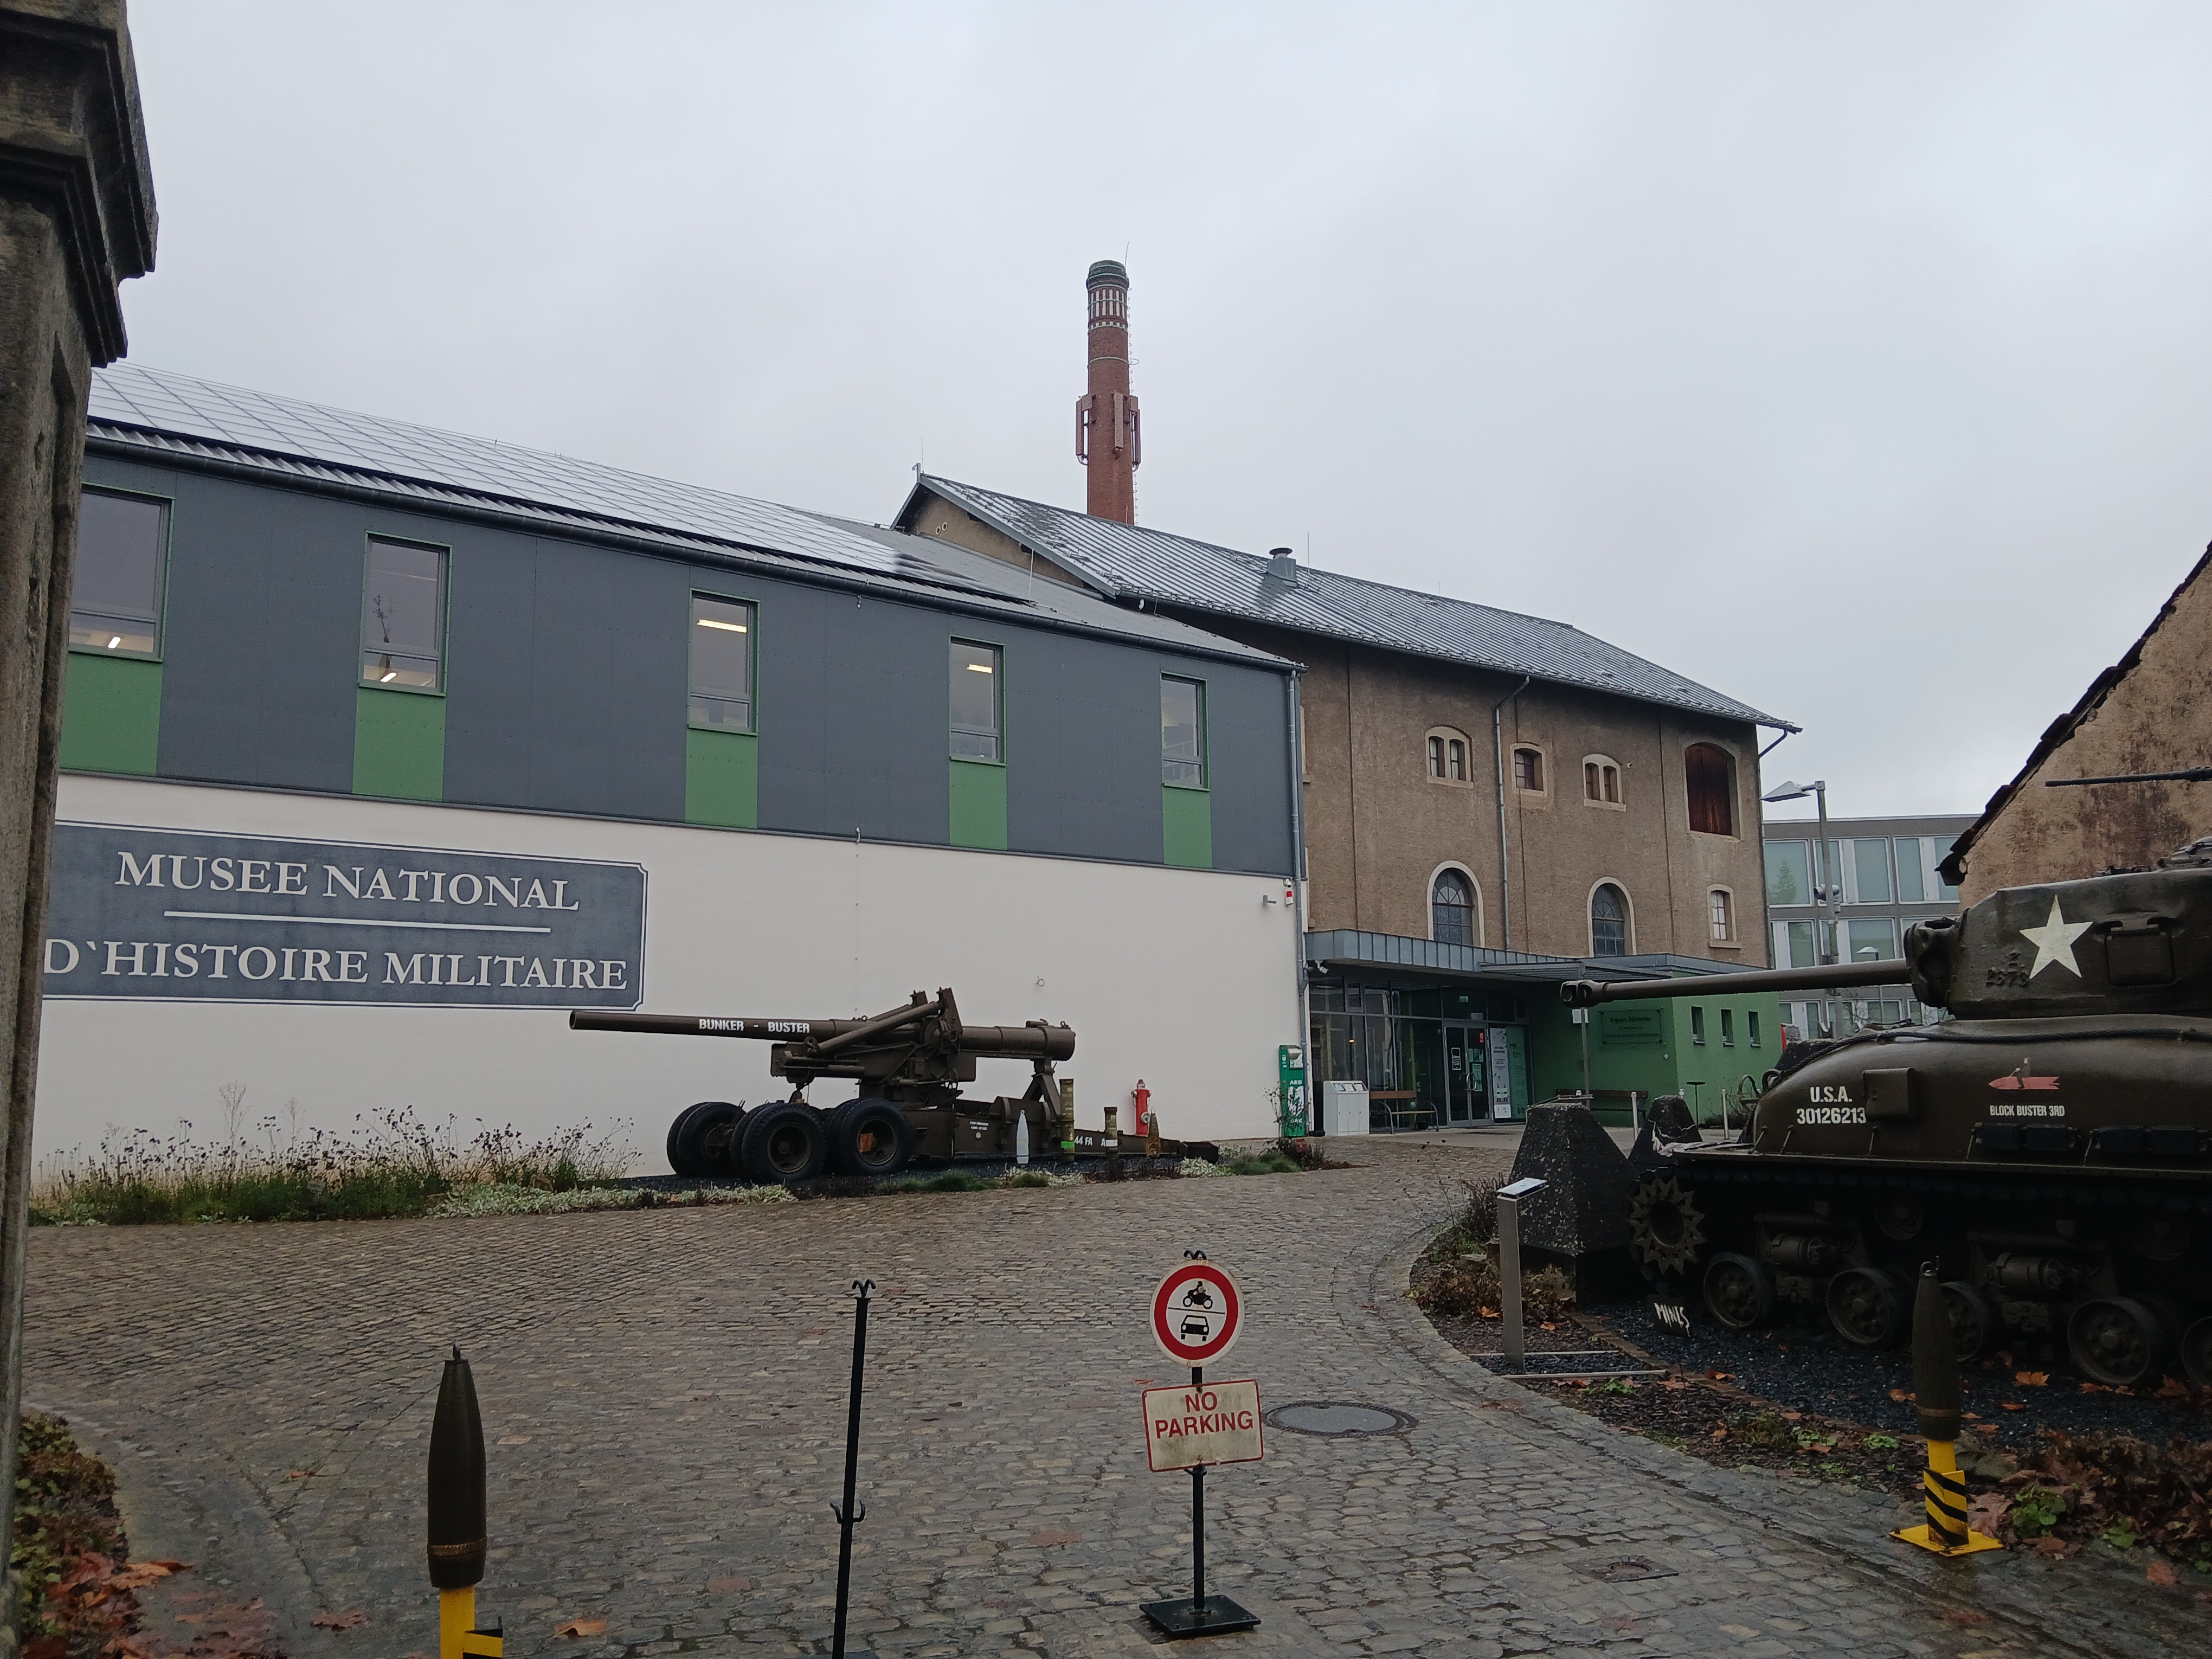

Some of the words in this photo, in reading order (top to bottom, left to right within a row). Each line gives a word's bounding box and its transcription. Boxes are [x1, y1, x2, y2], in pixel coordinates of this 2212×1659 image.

[114, 851, 308, 895] MUSEE
[322, 865, 580, 911] NATIONAL
[382, 951, 628, 990] MILITAIRE
[699, 1018, 744, 1031] BUNKER
[768, 1021, 811, 1033] BUSTER
[1810, 1086, 1853, 1103] U.S.A.
[1796, 1107, 1867, 1124] 30126213
[1989, 1105, 2015, 1116] BLOCK
[2016, 1105, 2047, 1116] BUSTER
[2048, 1105, 2065, 1116] 3RD
[1085, 1136, 1093, 1146] FA
[1185, 1391, 1218, 1413] NO
[1155, 1410, 1254, 1439] PARKING
